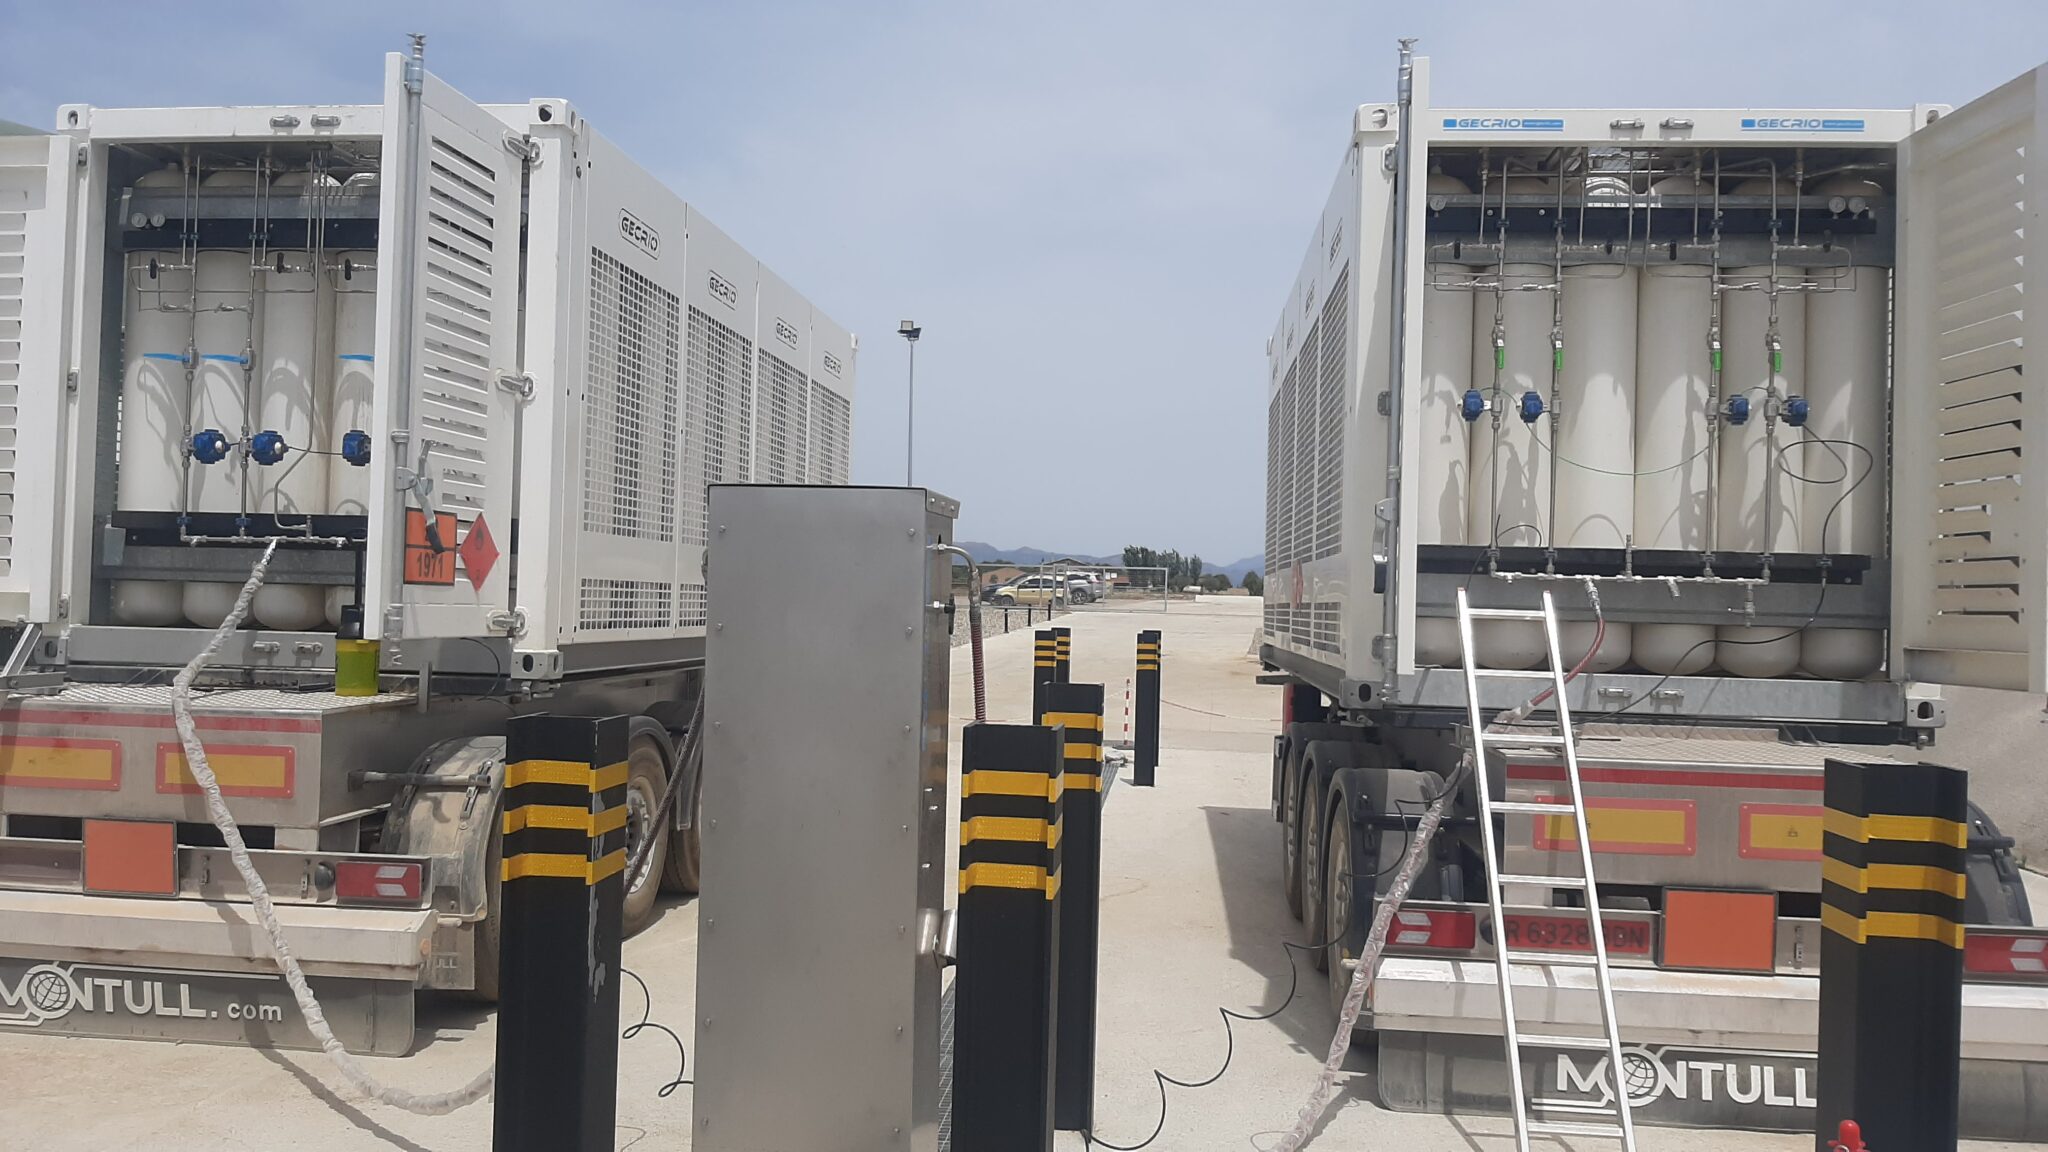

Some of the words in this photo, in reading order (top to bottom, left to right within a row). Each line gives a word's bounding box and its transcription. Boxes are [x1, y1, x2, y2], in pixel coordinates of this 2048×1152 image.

[1458, 118, 1521, 128] GECRIO
[1757, 118, 1821, 128] GECRIO
[621, 216, 658, 253] GECRIO
[709, 277, 736, 304] GECRIO
